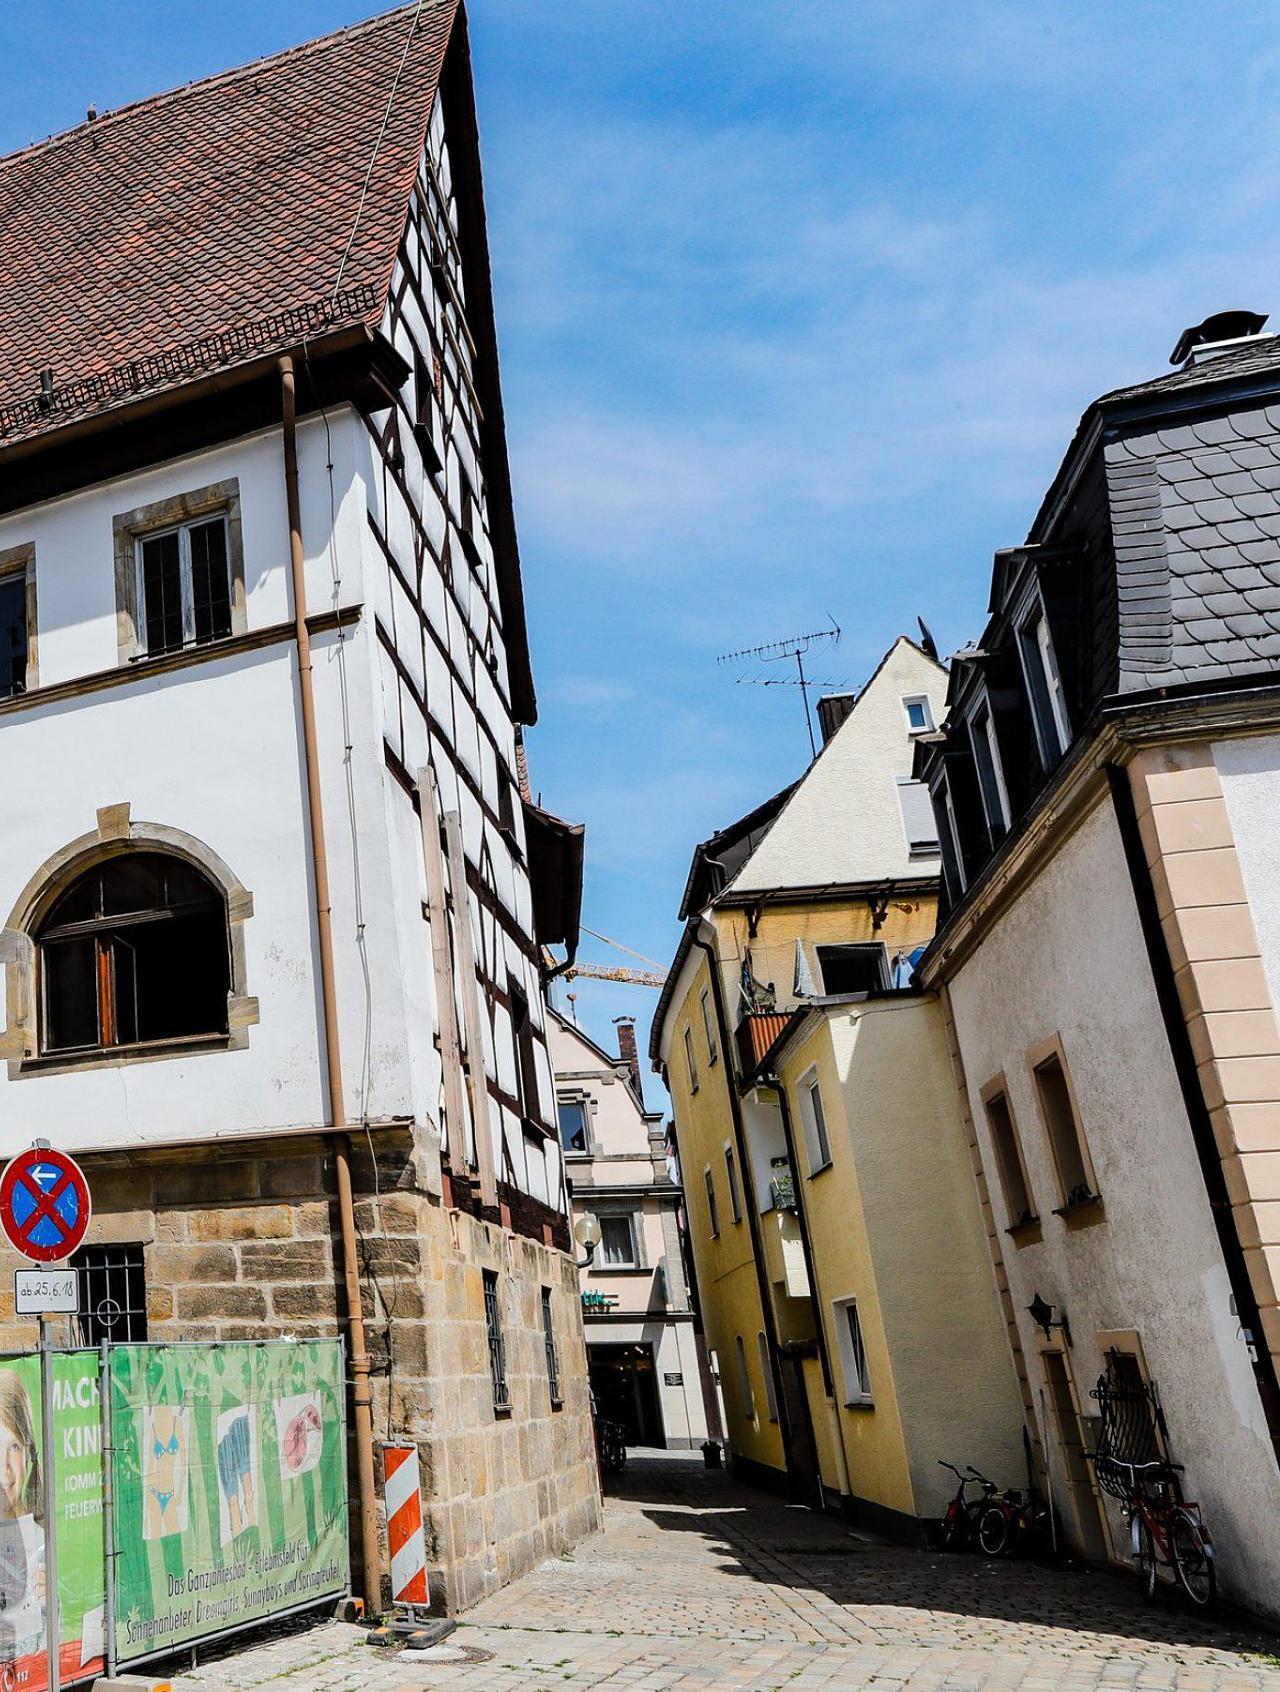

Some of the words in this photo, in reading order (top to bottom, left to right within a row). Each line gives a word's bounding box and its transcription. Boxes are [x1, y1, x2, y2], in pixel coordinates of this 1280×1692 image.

[20, 1282, 32, 1296] ab
[168, 1573, 185, 1597] Das
[284, 1570, 298, 1595] und
[16, 1670, 28, 1683] 112
